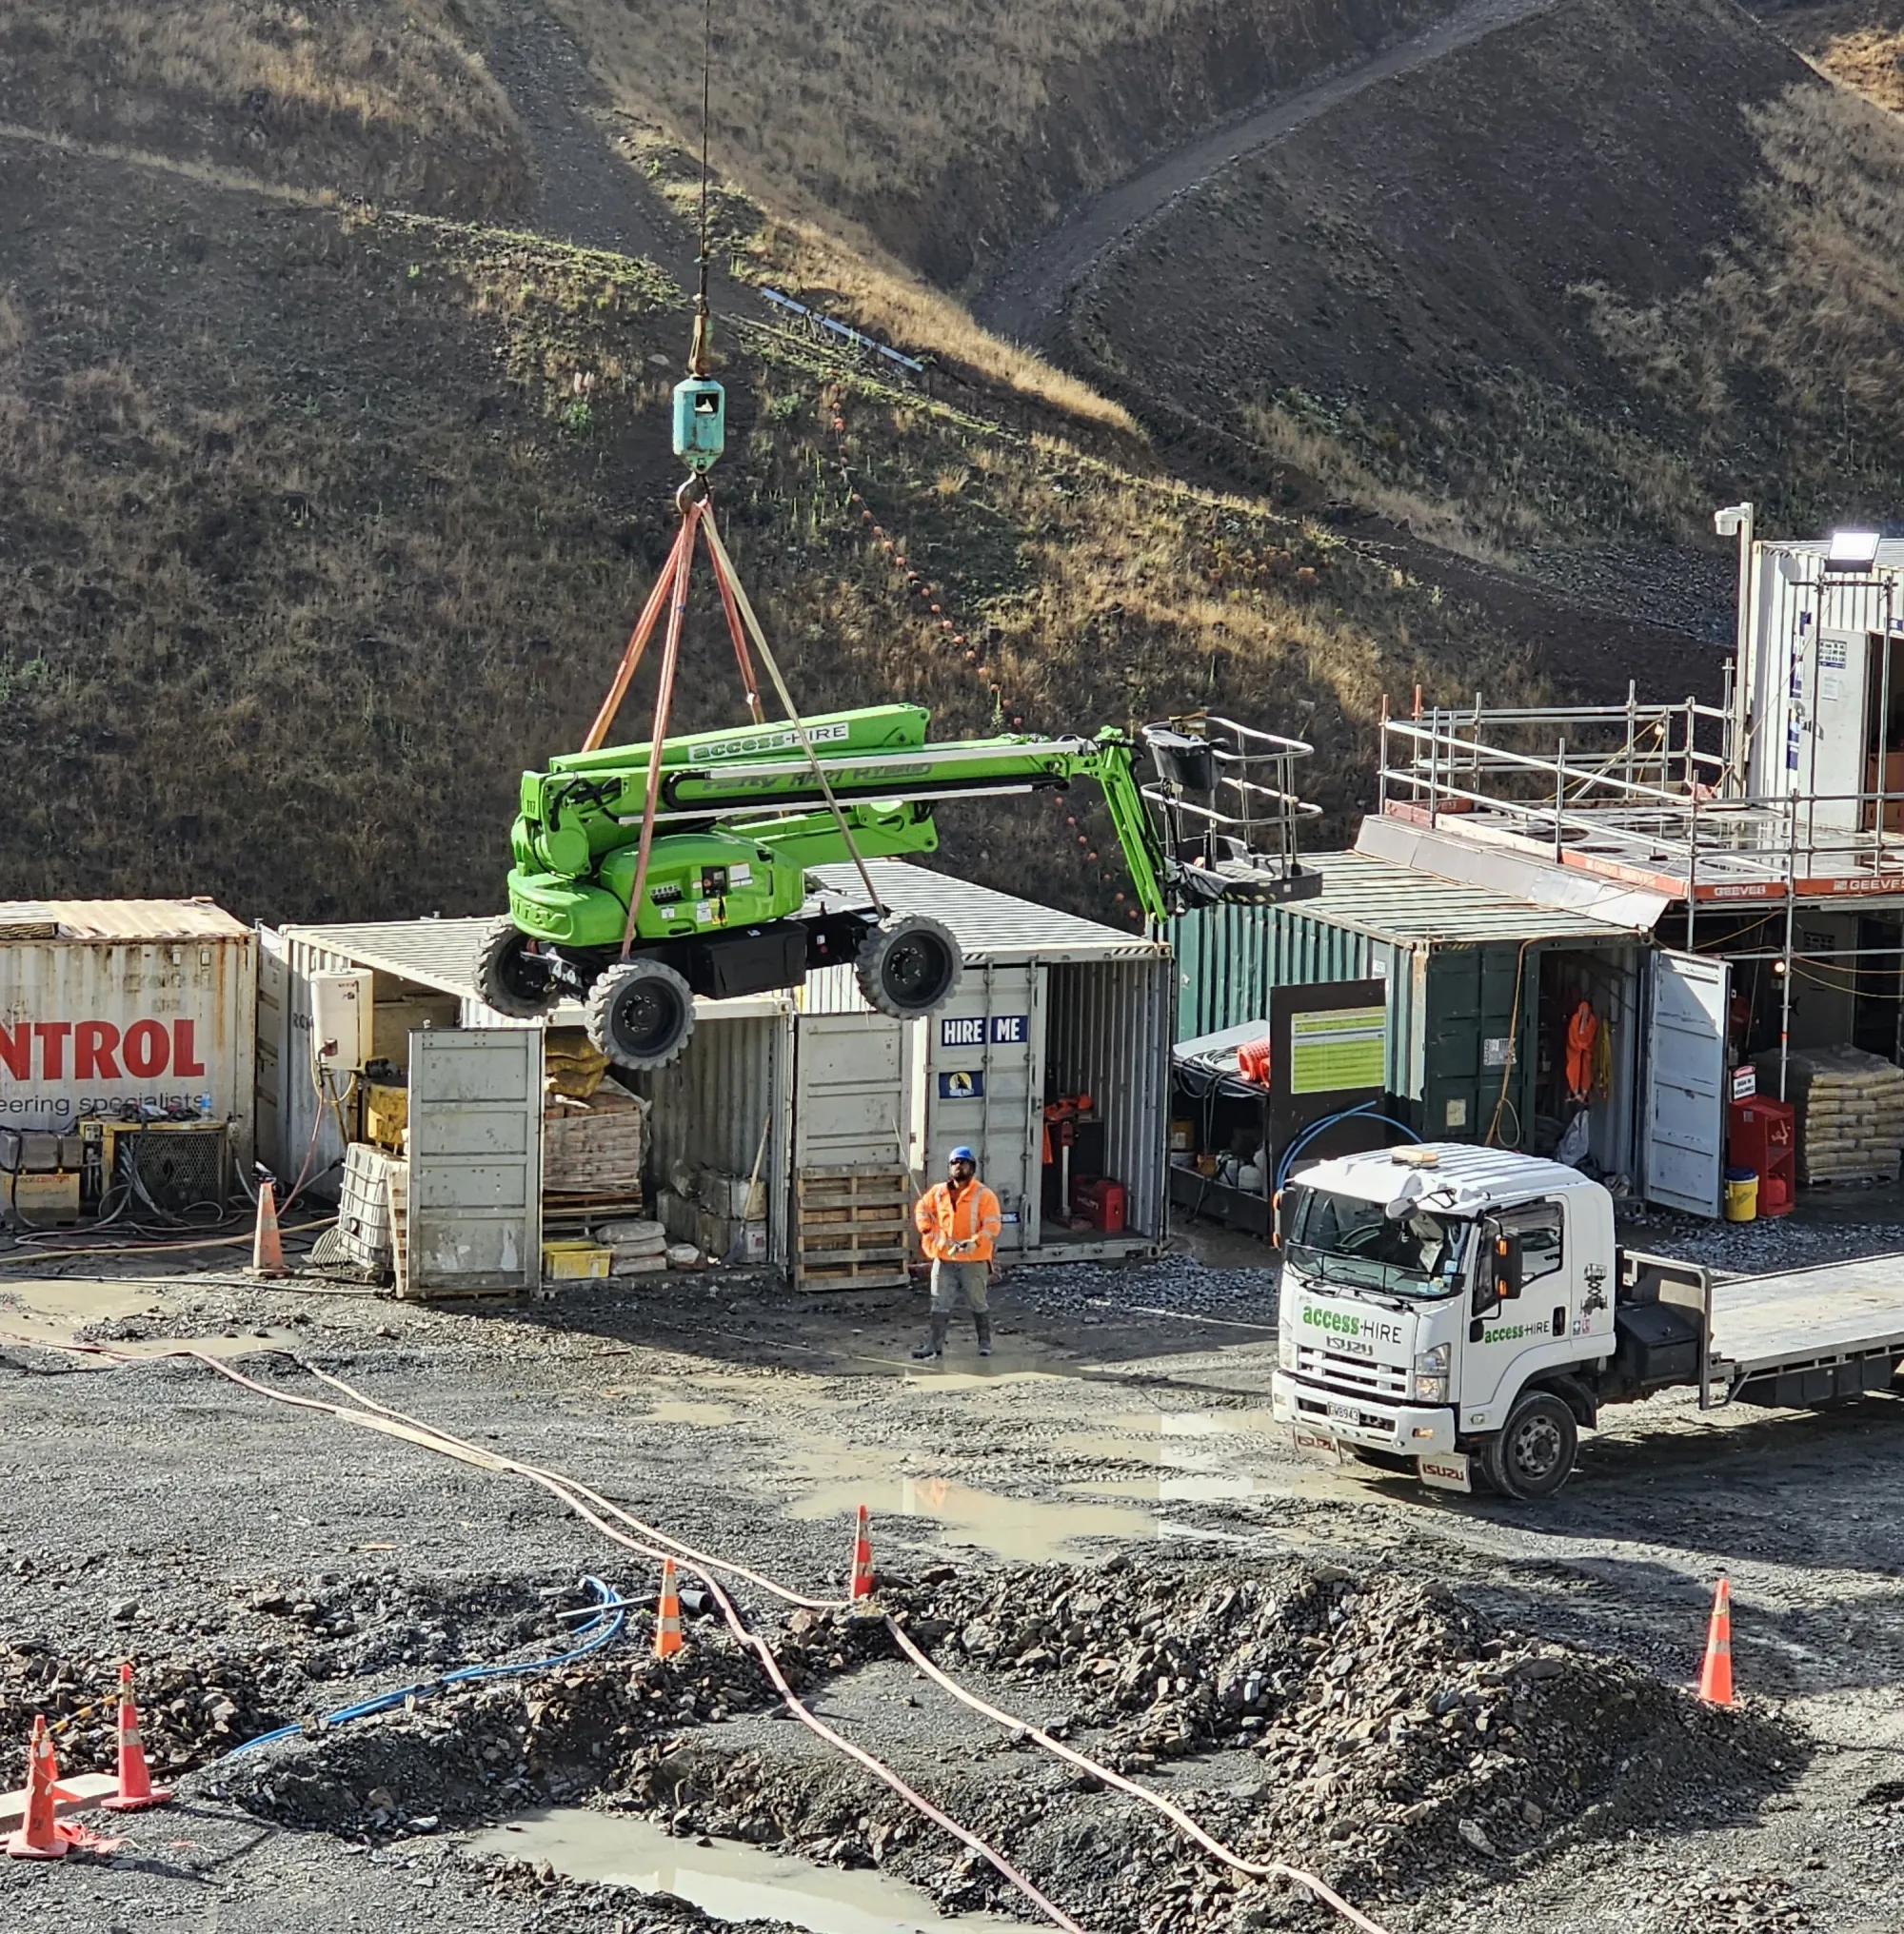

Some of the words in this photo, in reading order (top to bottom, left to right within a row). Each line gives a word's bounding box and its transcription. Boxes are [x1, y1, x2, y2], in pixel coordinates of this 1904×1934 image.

[1714, 886, 1766, 897] GEEVES
[943, 1019, 983, 1044] HIRE
[997, 1017, 1021, 1041] ME
[0, 1018, 206, 1081] NTROL
[0, 1095, 69, 1116] eering
[1326, 1335, 1373, 1356] ISUZU
[1421, 1463, 1464, 1482] ISUZU
